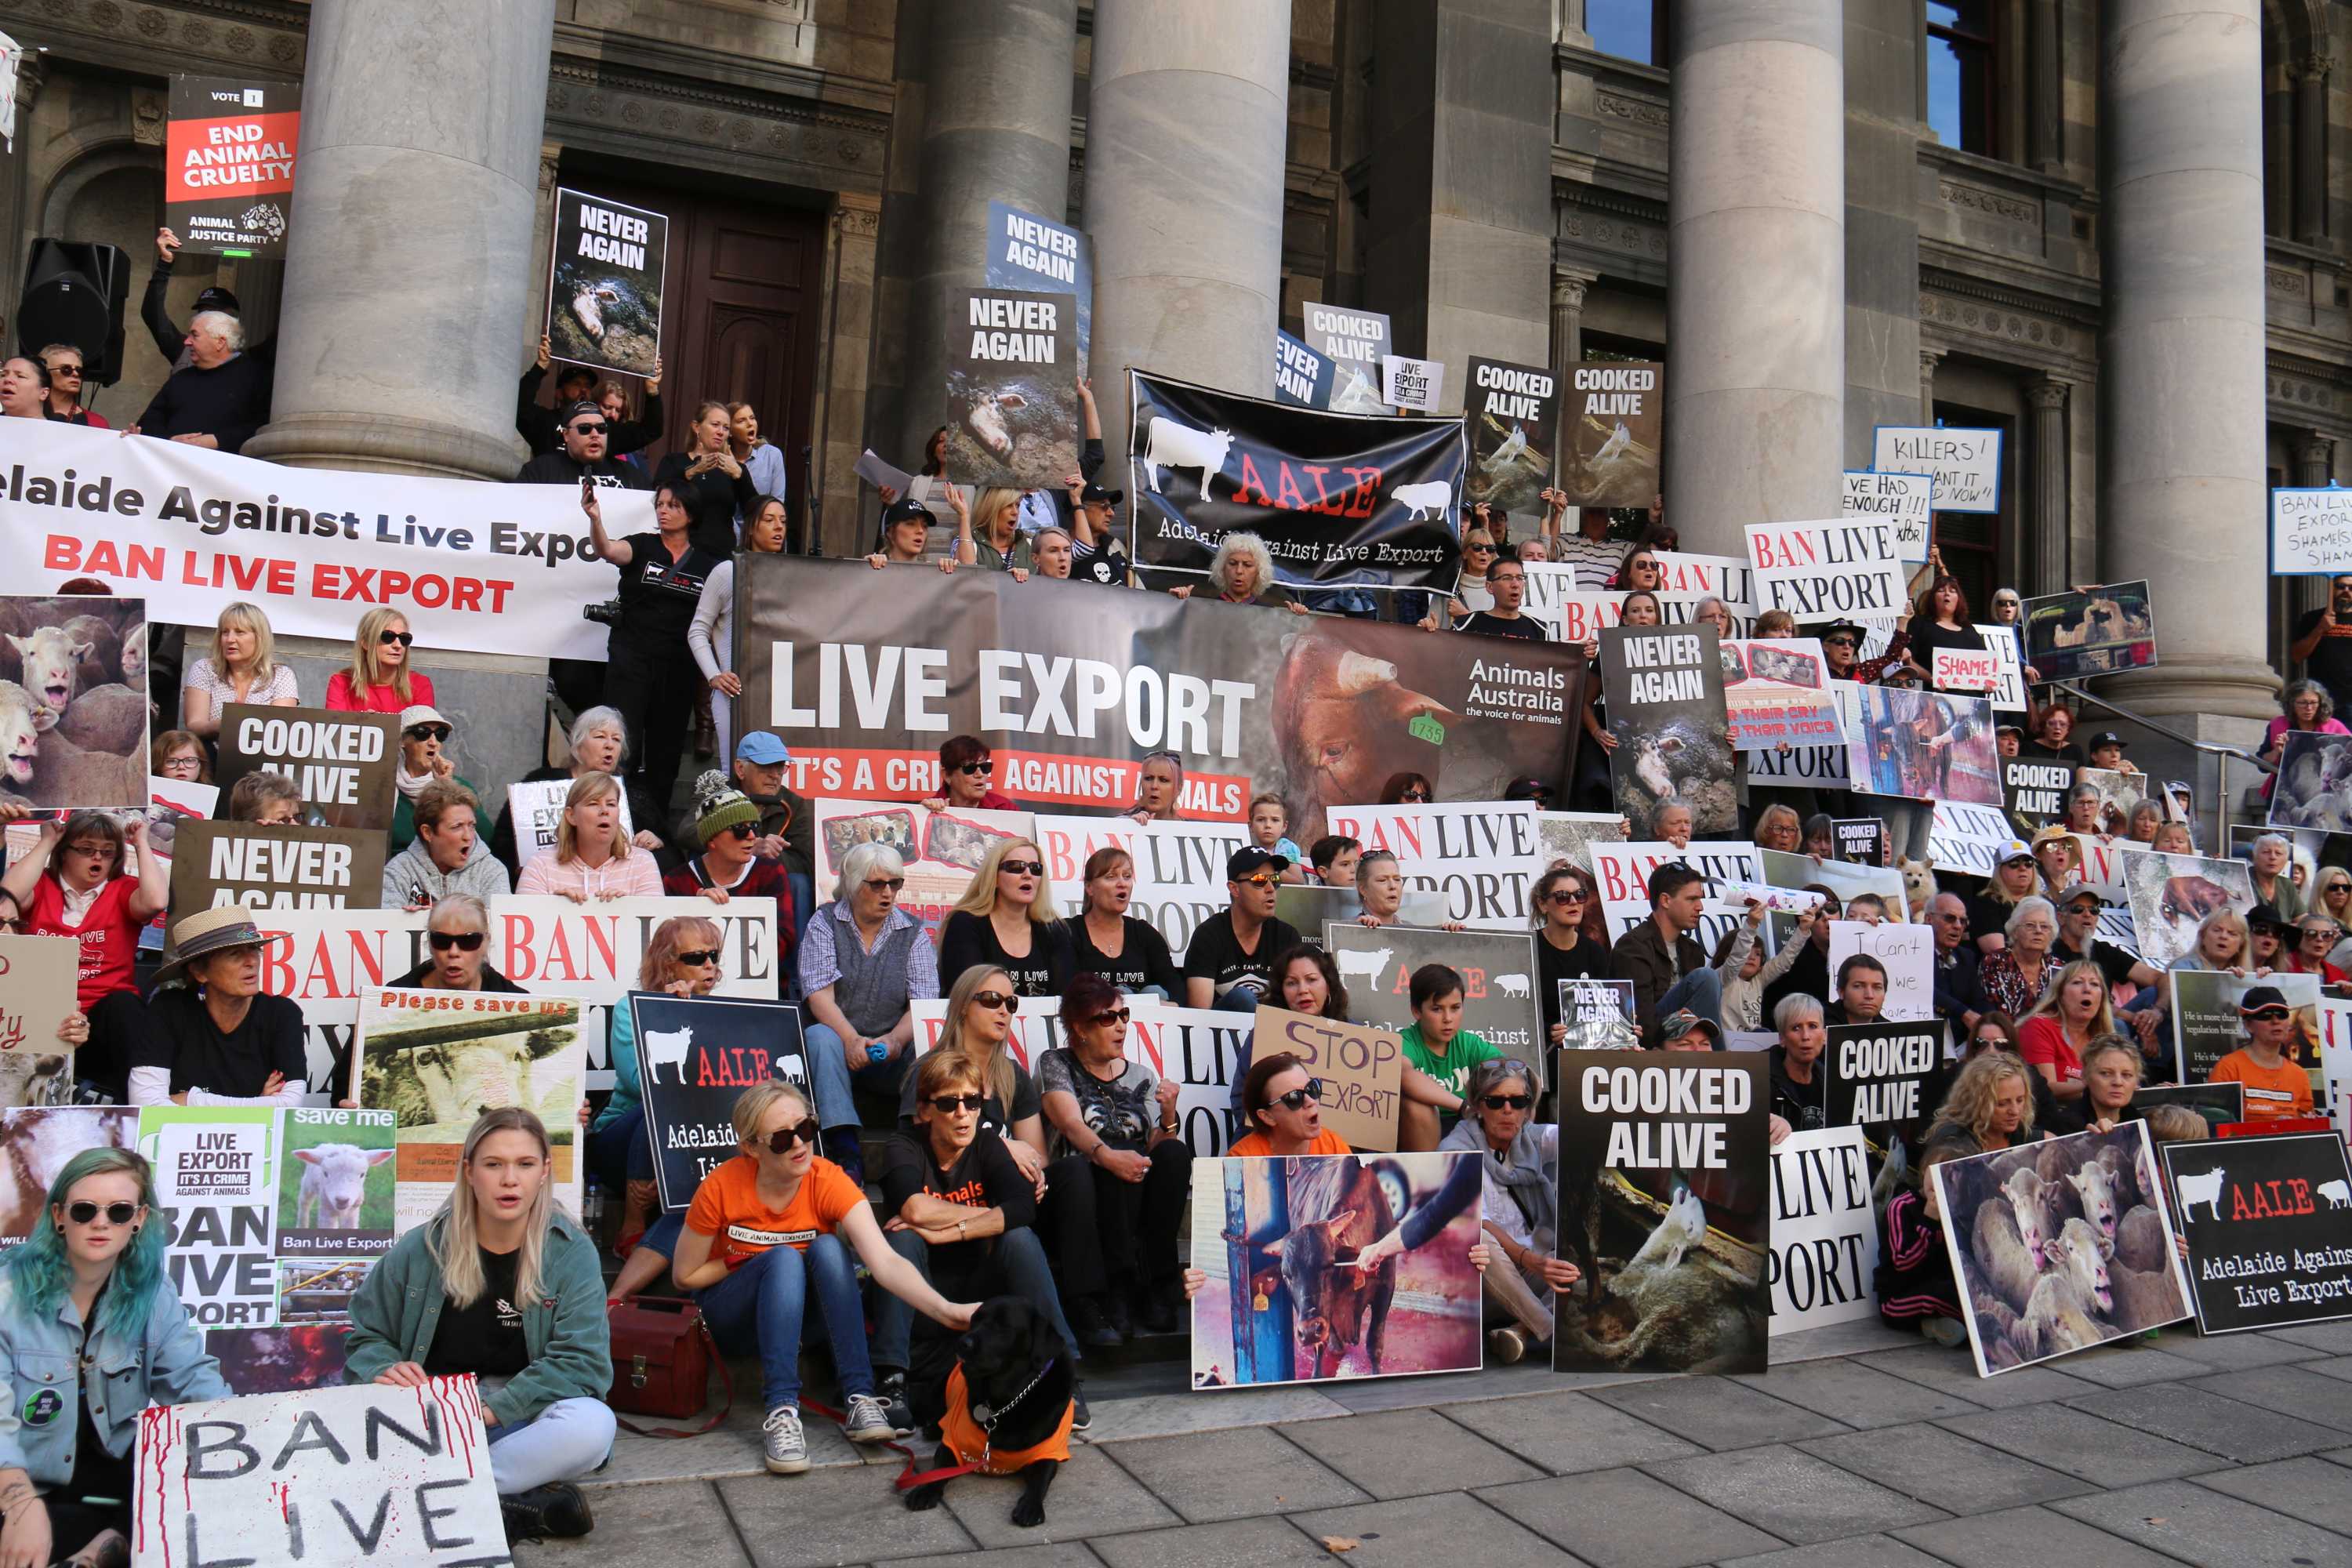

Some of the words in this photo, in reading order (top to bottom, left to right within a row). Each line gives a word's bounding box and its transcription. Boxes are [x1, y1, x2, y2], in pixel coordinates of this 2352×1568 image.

[211, 91, 241, 103] VOTE
[208, 124, 264, 145] END
[184, 141, 293, 168] ANIMAL
[183, 161, 295, 187] CRUELTY
[188, 229, 235, 242] JUSTICE
[237, 234, 268, 245] PARTY
[189, 216, 236, 229] ANIMAL
[579, 204, 648, 245] NEVER
[1007, 213, 1077, 259] NEVER
[578, 232, 645, 271] AGAIN
[1006, 240, 1075, 285] AGAIN
[969, 297, 1057, 331] NEVER
[1312, 310, 1384, 340] COOKED
[970, 330, 1055, 364] AGAIN
[1276, 336, 1319, 381] EVER
[1325, 336, 1376, 363] ALIVE
[1401, 361, 1421, 376] LIVE
[1476, 365, 1554, 398] COOKED
[1574, 368, 1656, 391] COOKED
[1276, 367, 1315, 405] AIN
[1484, 392, 1541, 422] ALIVE
[1584, 393, 1642, 416] ALIVE
[1231, 452, 1383, 519] AALE
[1878, 475, 1908, 495] HAD
[1964, 472, 1980, 487] IT
[0, 464, 145, 517] laide
[158, 485, 361, 541] Against
[376, 514, 474, 551] Live
[490, 521, 601, 568] Expo
[1843, 495, 1901, 514] ENOUGH
[2281, 495, 2319, 515] BAN
[1157, 517, 1229, 549] Adelaid
[1264, 539, 1320, 562] ainst
[1323, 543, 1369, 563] Live
[1374, 543, 1444, 565] Export
[1893, 518, 1929, 543] XPORT
[1751, 529, 1818, 569] BAN
[1820, 524, 1895, 564] LIVE
[44, 533, 166, 582] BAN
[181, 550, 297, 596] LIVE
[310, 562, 514, 614] EXPORT
[1524, 572, 1570, 609] IVE
[1767, 572, 1894, 615] EXPORT
[1623, 633, 1702, 668] NEVER
[1468, 659, 1565, 690] Animals
[1936, 655, 1998, 678] SHAME!
[771, 641, 949, 731] LIVE
[978, 649, 1256, 758] EXPORT
[1467, 682, 1563, 712] Australia
[1630, 670, 1704, 705] AGAIN
[1466, 706, 1482, 717] the
[1484, 707, 1510, 720] voice
[1512, 710, 1525, 721] for
[1527, 713, 1563, 725] animals
[238, 717, 385, 763] COOKED
[1748, 745, 1851, 779] XPORT
[2006, 764, 2071, 789] COOKED
[260, 762, 361, 805] IVE
[853, 757, 876, 790] A
[1004, 758, 1127, 800] AGAINST
[2015, 789, 2061, 814] ALIVE
[1334, 815, 1424, 861] BAN
[1432, 812, 1536, 859] LIVE
[1838, 825, 1877, 840] COOKED
[1945, 806, 2014, 841] LIVE
[209, 836, 353, 887] NEVER
[1845, 839, 1873, 854] ALIVE
[80, 930, 105, 944] IVE
[500, 914, 621, 982] BAN
[1301, 935, 1323, 944] more
[1853, 931, 1867, 955] I
[1875, 933, 1921, 958] Can't
[256, 928, 389, 1000] BAN
[1025, 970, 1049, 982] LIVE
[1116, 971, 1145, 983] LIVE
[1573, 988, 1621, 1004] NEVER
[1896, 975, 1918, 990] we
[380, 991, 464, 1011] Please
[474, 996, 530, 1014] save
[539, 1000, 568, 1016] us
[1576, 1006, 1620, 1022] AGAIN
[1915, 1003, 1930, 1019] to
[2184, 1011, 2195, 1021] He
[2197, 1012, 2203, 1021] is
[2222, 1012, 2237, 1022] than
[1286, 1021, 1396, 1080] STOP
[1839, 1034, 1934, 1080] COOKED
[697, 1046, 772, 1088] AALE
[1319, 1077, 1400, 1120] EXPORT
[1581, 1066, 1751, 1115] COOKED
[1852, 1080, 1919, 1124] ALIVE
[294, 1109, 350, 1127] save
[355, 1109, 394, 1127] me
[196, 1133, 237, 1150] LIVE
[667, 1123, 739, 1149] Adelaid
[1605, 1121, 1727, 1169] ALIVE
[177, 1152, 253, 1170] EXPORT
[176, 1187, 212, 1196] AGAINST
[213, 1187, 251, 1196] ANIMALS
[180, 1173, 201, 1185] IT'S
[202, 1174, 211, 1185] A
[212, 1173, 249, 1185] CRIME
[1769, 1144, 1867, 1221] LIVE
[2232, 1178, 2316, 1221] AALE
[282, 1236, 311, 1248] Ban
[315, 1236, 343, 1248] Live
[347, 1236, 394, 1250] Export
[730, 1229, 749, 1239] LIVE
[750, 1233, 779, 1243] ANIMAL
[168, 1253, 274, 1297] IVE
[2202, 1253, 2287, 1281] Adelaide
[2234, 1285, 2281, 1308] Live
[2284, 1273, 2352, 1305] Export
[186, 1399, 443, 1480] BAN
[184, 1478, 474, 1568] LIVE
